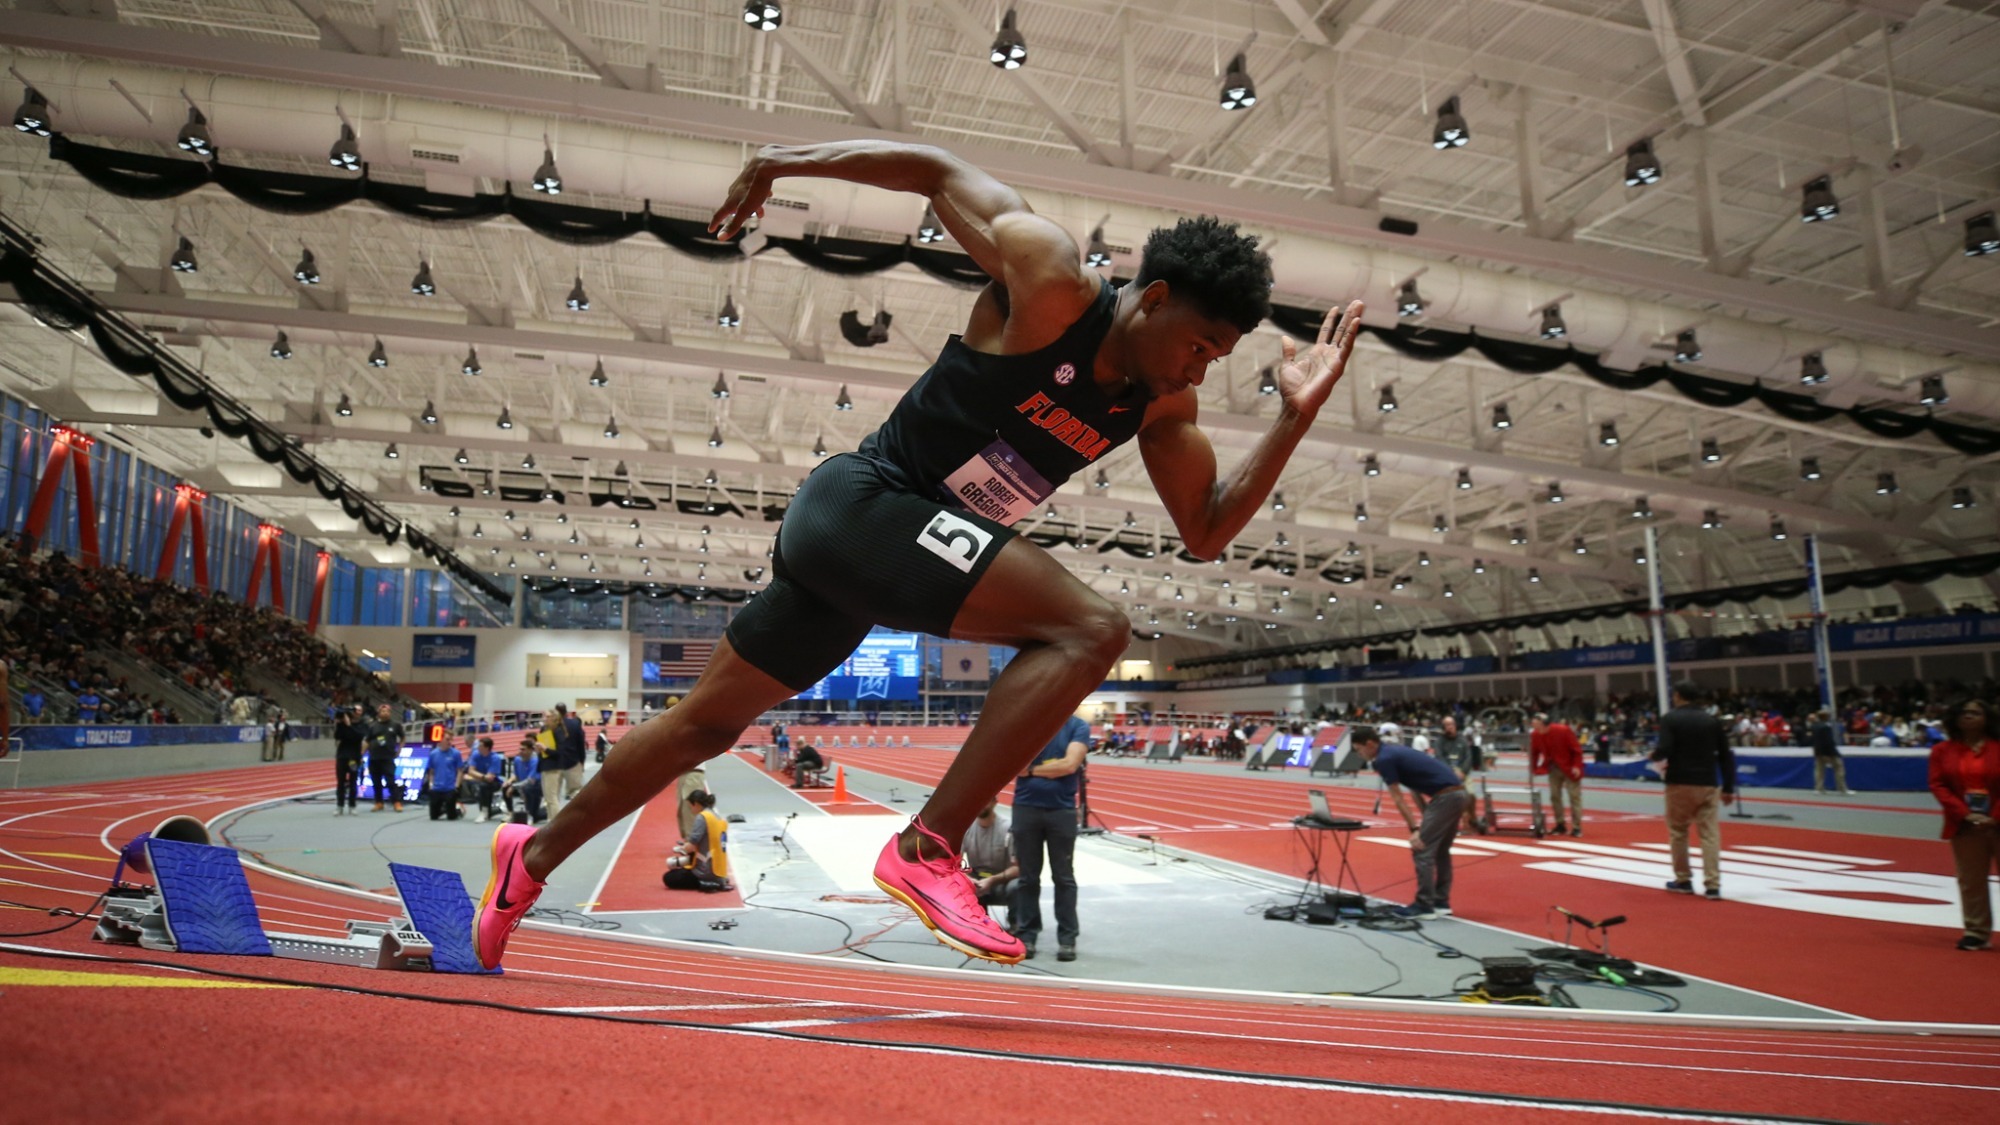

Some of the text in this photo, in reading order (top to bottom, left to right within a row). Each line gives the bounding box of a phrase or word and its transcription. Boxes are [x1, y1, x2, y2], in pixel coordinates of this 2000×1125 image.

[1056, 364, 1076, 384] SEC
[1015, 390, 1111, 461] FLORIDA
[960, 481, 1012, 521] GREGORY
[983, 476, 1020, 506] ROBERT
[927, 517, 980, 561] 5
[86, 730, 108, 744] TRACK
[114, 730, 132, 743] FIELD
[432, 725, 444, 742] 0
[397, 932, 424, 940] GILL
